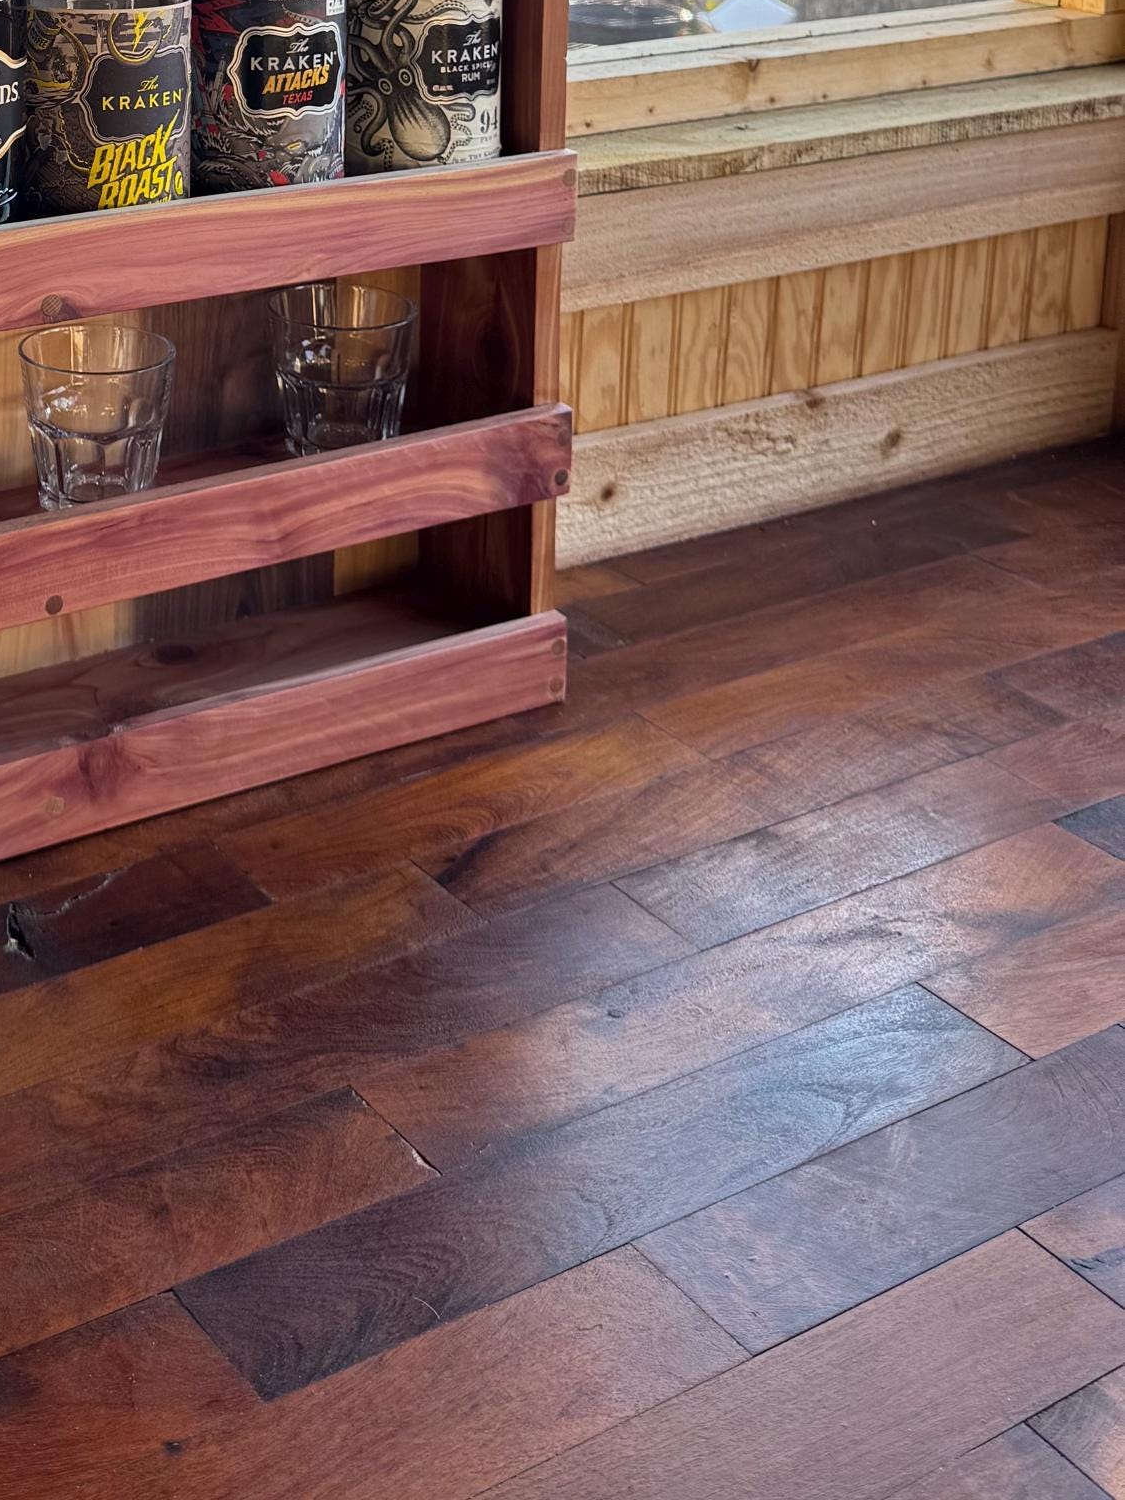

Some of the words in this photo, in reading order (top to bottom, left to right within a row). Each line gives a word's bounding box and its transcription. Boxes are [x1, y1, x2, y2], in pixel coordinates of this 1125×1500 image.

[286, 37, 309, 54] The
[463, 30, 482, 46] The
[250, 51, 334, 71] KRAKEN
[431, 41, 499, 64] KRAKEN
[440, 64, 469, 73] BLACK
[137, 75, 159, 92] The
[261, 63, 330, 95] ATTACKS
[461, 72, 481, 83] RUM
[102, 88, 183, 111] KRAKEN
[282, 90, 314, 105] TEXAS
[87, 108, 180, 190] BLACK
